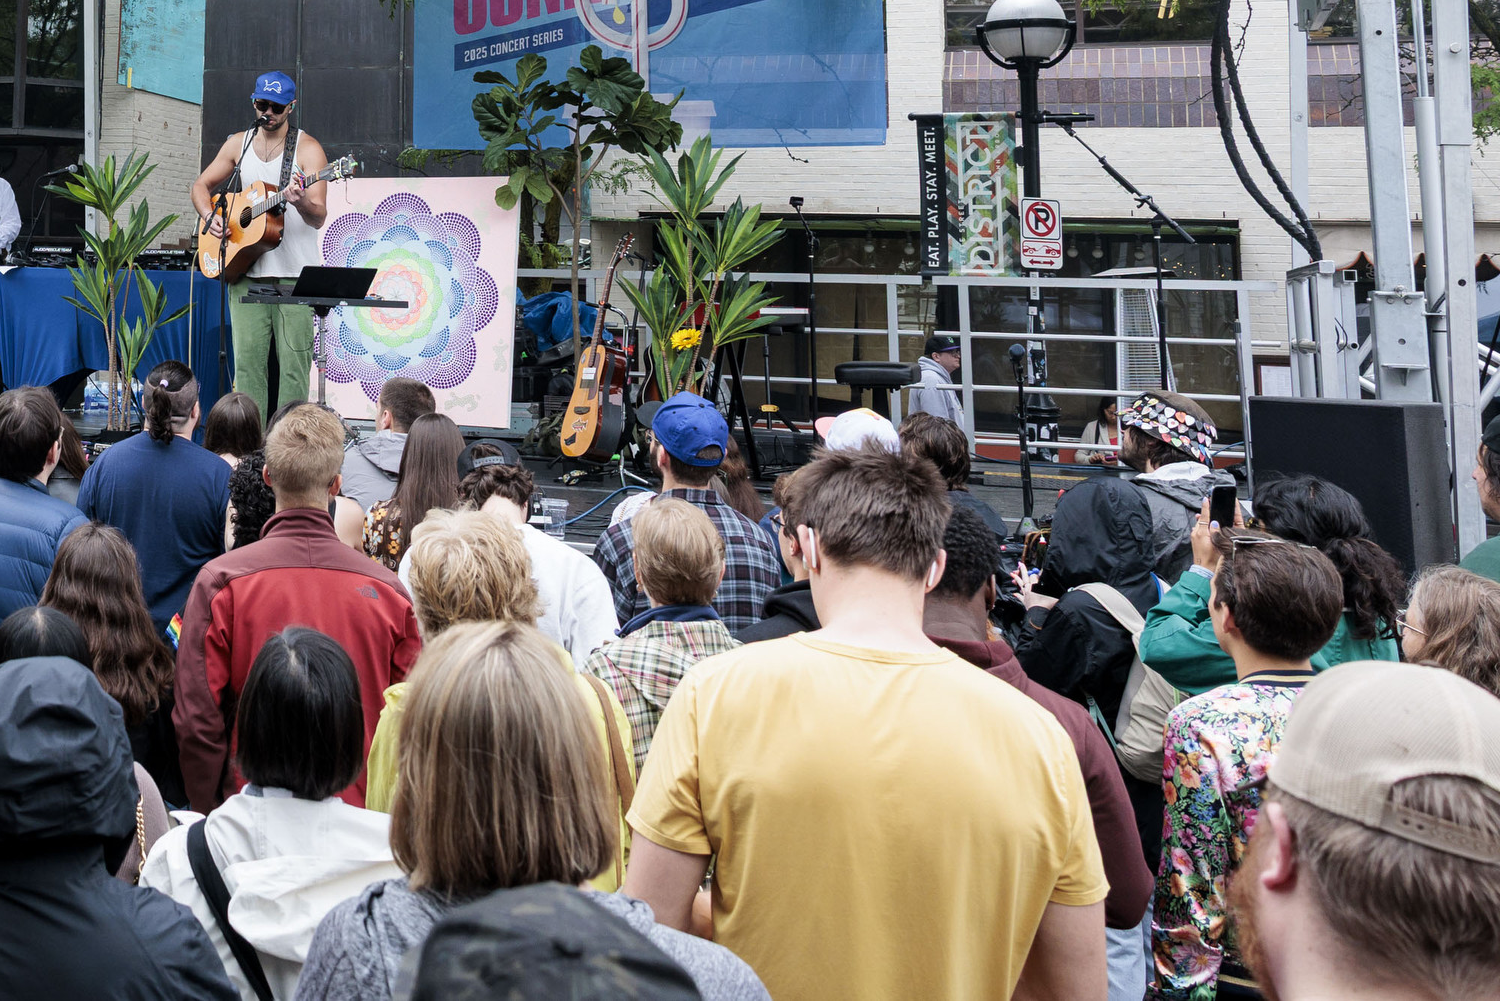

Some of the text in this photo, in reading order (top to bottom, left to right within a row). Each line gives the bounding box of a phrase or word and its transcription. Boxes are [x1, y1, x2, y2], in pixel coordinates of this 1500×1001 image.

[464, 28, 564, 62] 2025 CONCERT SERIES
[924, 127, 940, 268] EAT. PLAY. STAY. MEET.
[966, 128, 995, 265] DISTRICT
[958, 237, 966, 265] STE
